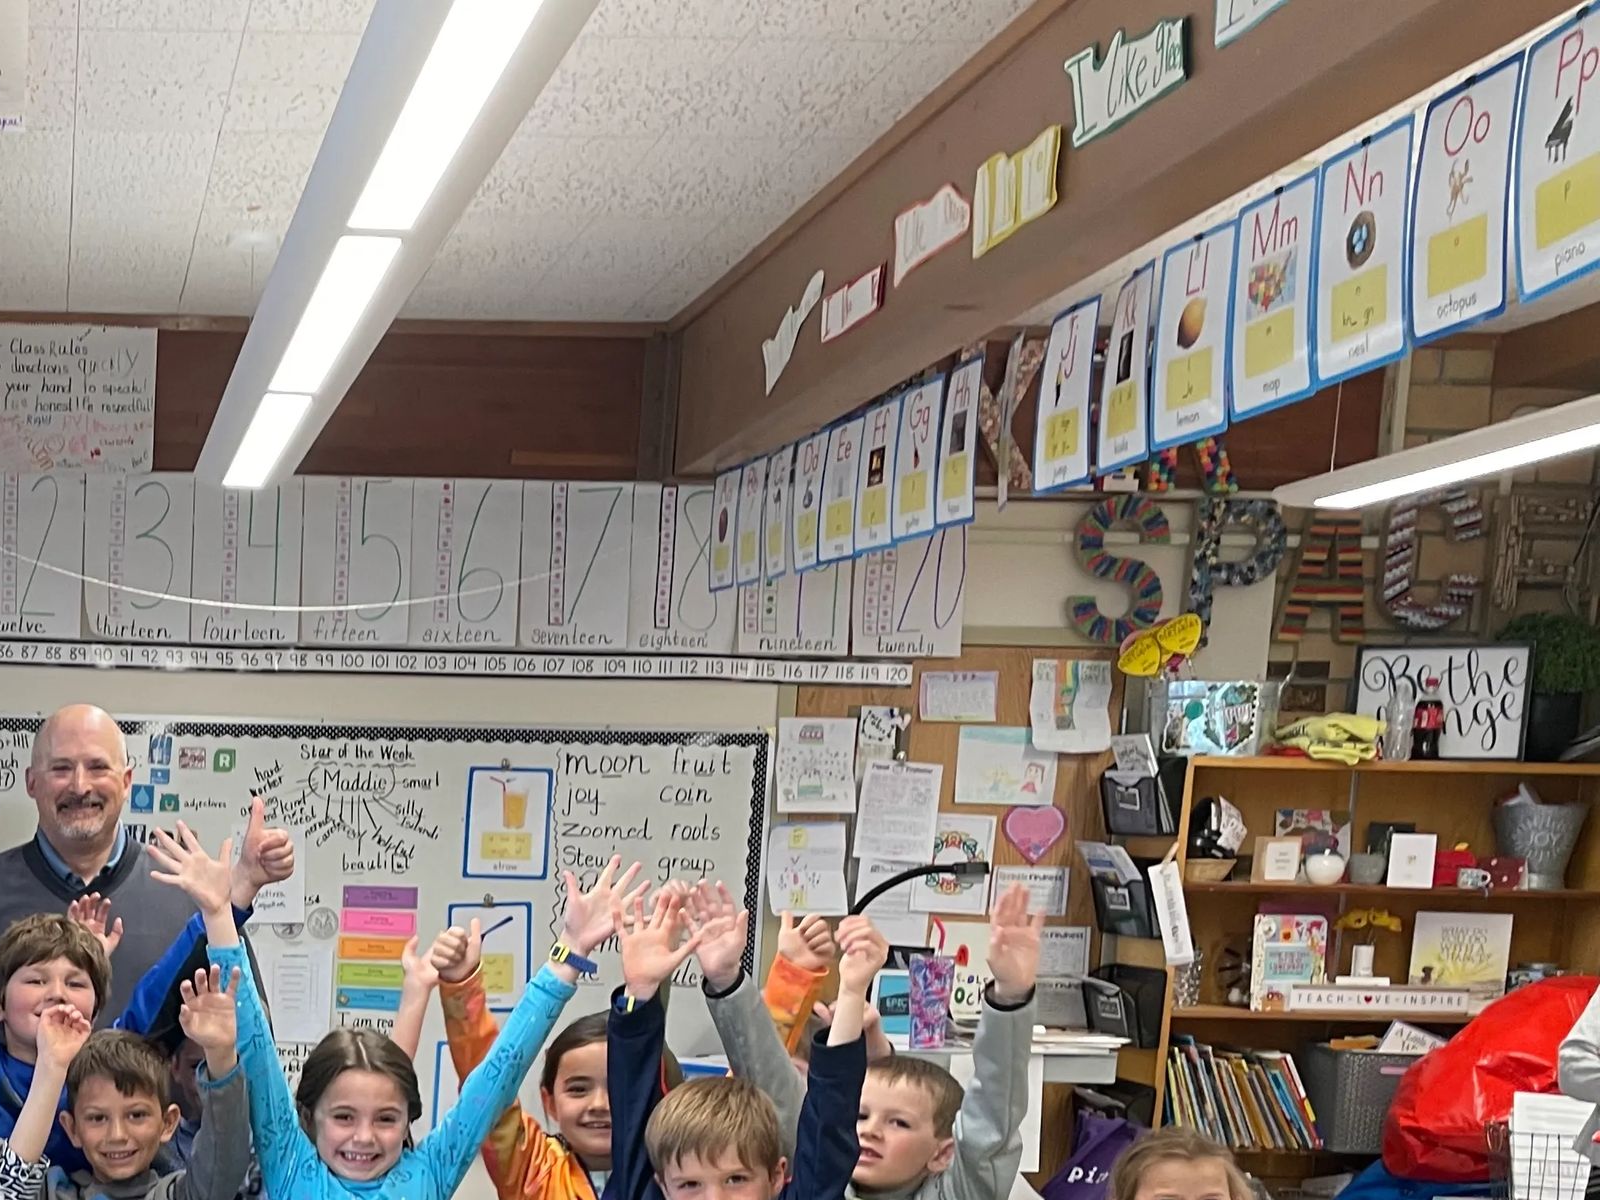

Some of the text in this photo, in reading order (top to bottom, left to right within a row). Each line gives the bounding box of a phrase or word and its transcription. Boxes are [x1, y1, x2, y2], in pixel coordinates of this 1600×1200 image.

[1555, 28, 1600, 115] Pp
[1443, 96, 1491, 156] Oo
[1344, 149, 1384, 214] Nn
[1252, 200, 1298, 261] Mm
[1555, 242, 1585, 274] piano
[1437, 291, 1477, 319] octopus
[10, 338, 44, 355] Class
[49, 337, 88, 356] Rules
[6, 378, 72, 398] your hand
[1262, 379, 1280, 396] map
[1176, 410, 1200, 427] lemon
[836, 426, 852, 462] Ee
[95, 615, 172, 638] thirteen
[202, 619, 285, 641] fourteen
[313, 618, 382, 641] fifteen
[422, 628, 501, 642] sixteen
[530, 628, 613, 646] seventeen
[638, 631, 708, 648] eighteen
[759, 635, 837, 652] nineteen
[877, 637, 935, 655] twenty
[216, 652, 234, 666] 95
[341, 655, 364, 668] 100
[484, 657, 908, 682] 105 112 120
[1446, 651, 1526, 705] the
[301, 744, 414, 761] Star of the Week
[565, 748, 731, 775] moon fruit
[254, 761, 282, 782] hard
[323, 770, 388, 792] Maddie
[402, 773, 439, 790] smart
[184, 798, 227, 810] adjectives
[562, 783, 712, 815] joy coin
[562, 814, 720, 841] zoomed roots
[1526, 833, 1558, 851] JOY
[343, 853, 410, 873] beautiful
[658, 856, 715, 880] group
[1442, 926, 1470, 935] WHAT
[885, 998, 908, 1008] EPIC
[1297, 994, 1464, 1006] TEACH INSPIRE
